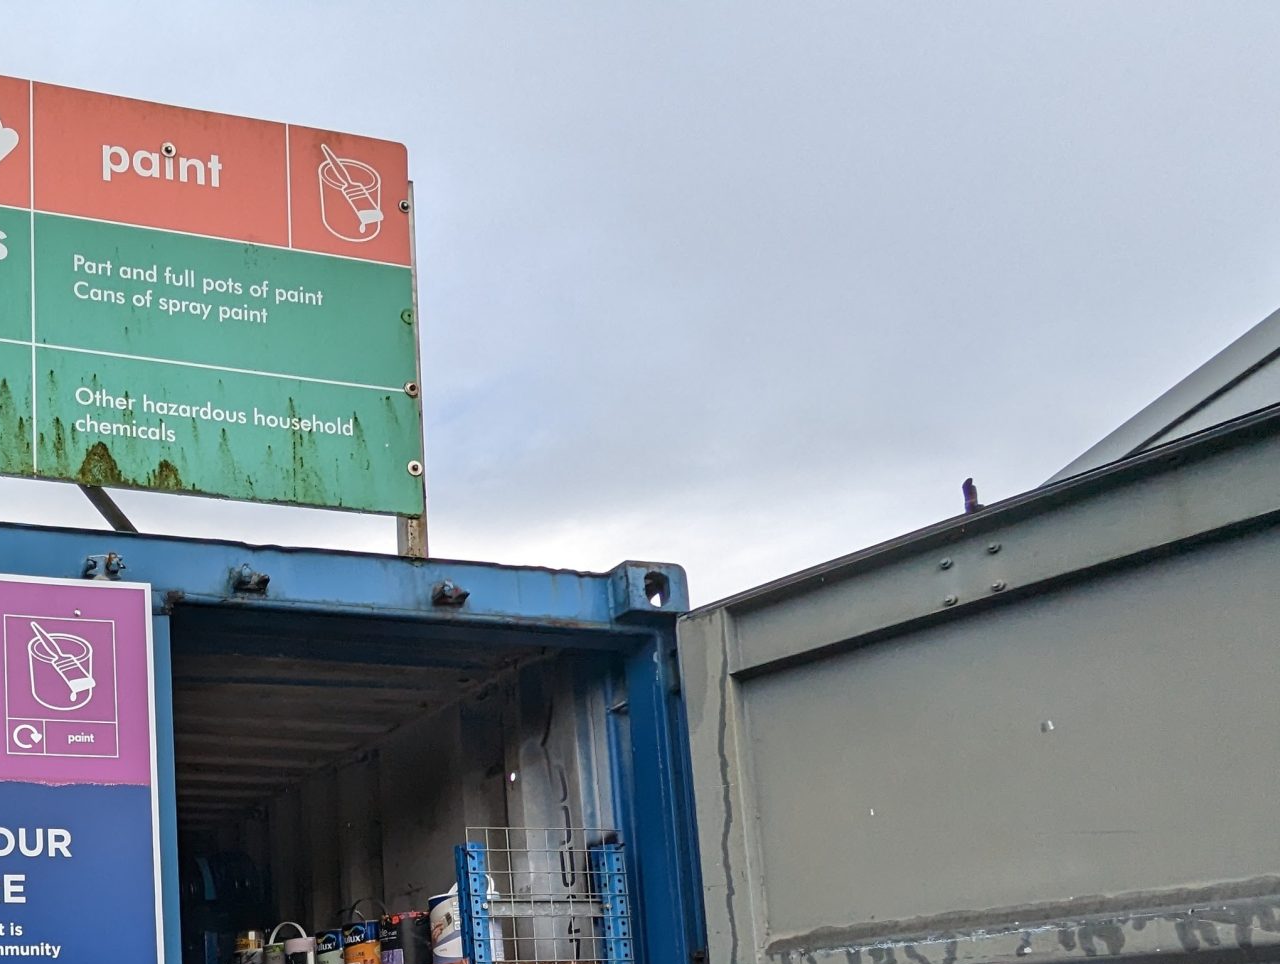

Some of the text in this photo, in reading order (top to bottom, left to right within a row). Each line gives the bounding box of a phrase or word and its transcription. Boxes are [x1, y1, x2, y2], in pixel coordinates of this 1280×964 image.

[102, 142, 222, 187] paint
[74, 254, 323, 305] Part and full pots of paint
[74, 281, 268, 323] Cans of spray paint
[75, 387, 353, 436] Other hazardous household
[75, 414, 176, 442] chemicals
[68, 732, 94, 744] paint
[10, 923, 23, 936] is
